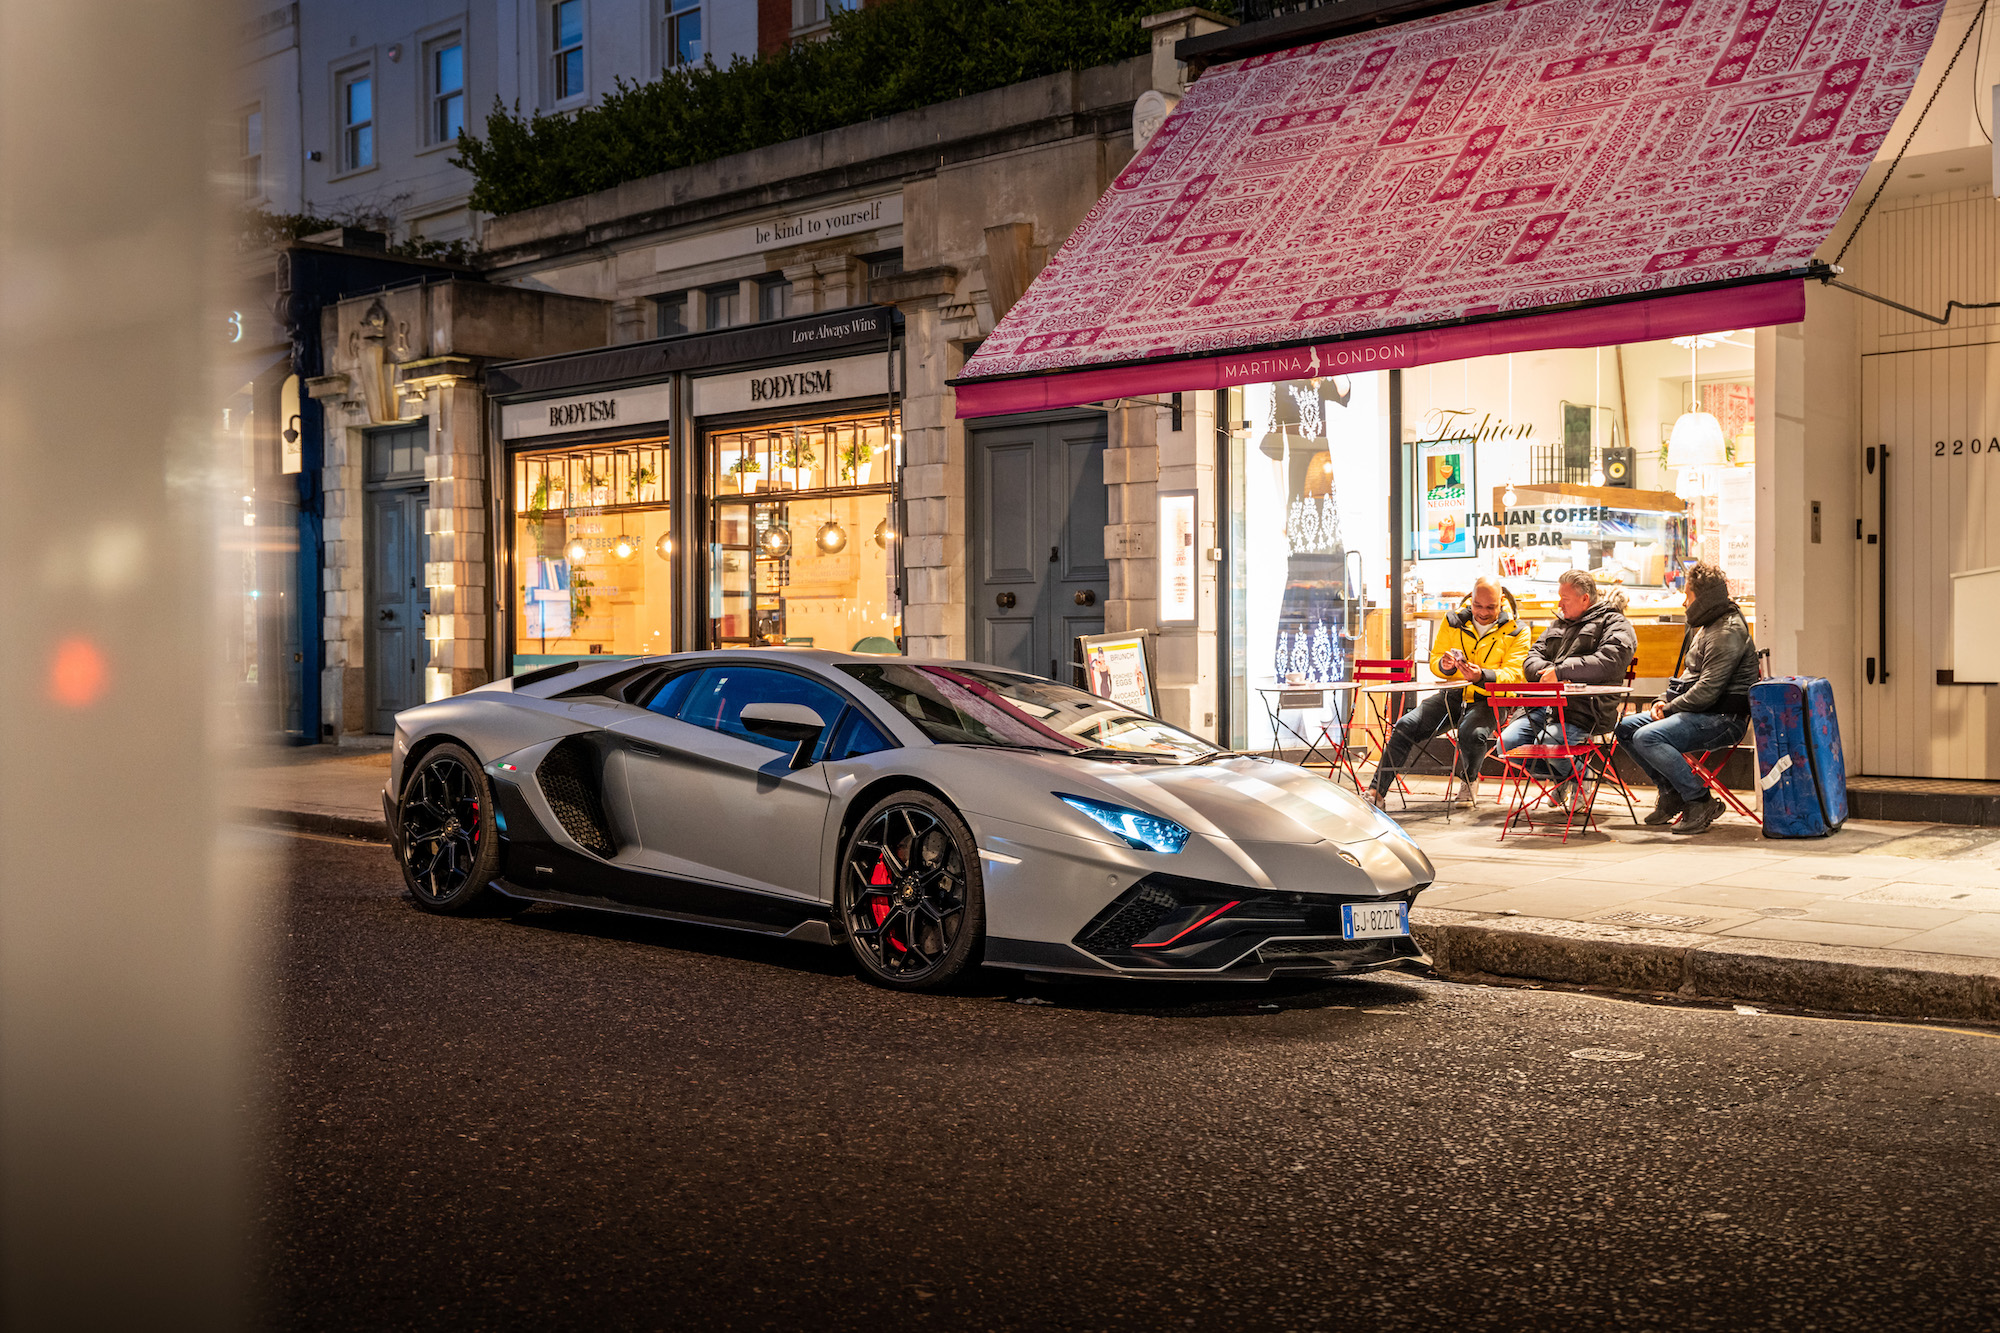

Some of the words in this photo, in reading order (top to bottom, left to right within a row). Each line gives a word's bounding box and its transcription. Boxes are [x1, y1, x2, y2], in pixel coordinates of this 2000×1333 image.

[756, 227, 771, 244] be
[774, 218, 803, 241] kind
[808, 220, 821, 233] to
[825, 201, 882, 236] yourself
[792, 330, 815, 344] Love
[815, 324, 850, 339] Always
[851, 318, 877, 333] Wins
[1225, 356, 1302, 378] MARTINA
[1327, 344, 1406, 367] LONDON
[751, 369, 832, 401] BODYISM
[549, 399, 616, 427] BODYISM
[1420, 407, 1537, 449] Fashion
[1935, 437, 2000, 457] 220A
[563, 506, 603, 519] POSITIVE
[1427, 499, 1465, 508] NEGRONI
[1466, 509, 1536, 528] ITALIAN
[1542, 506, 1609, 524] COFFEE
[596, 537, 617, 548] BEST
[1473, 533, 1520, 549] WINE
[1526, 531, 1563, 547] BAR
[1728, 541, 1749, 550] TEAM
[1110, 652, 1135, 661] BRUNCH
[1115, 679, 1132, 687] EGGS
